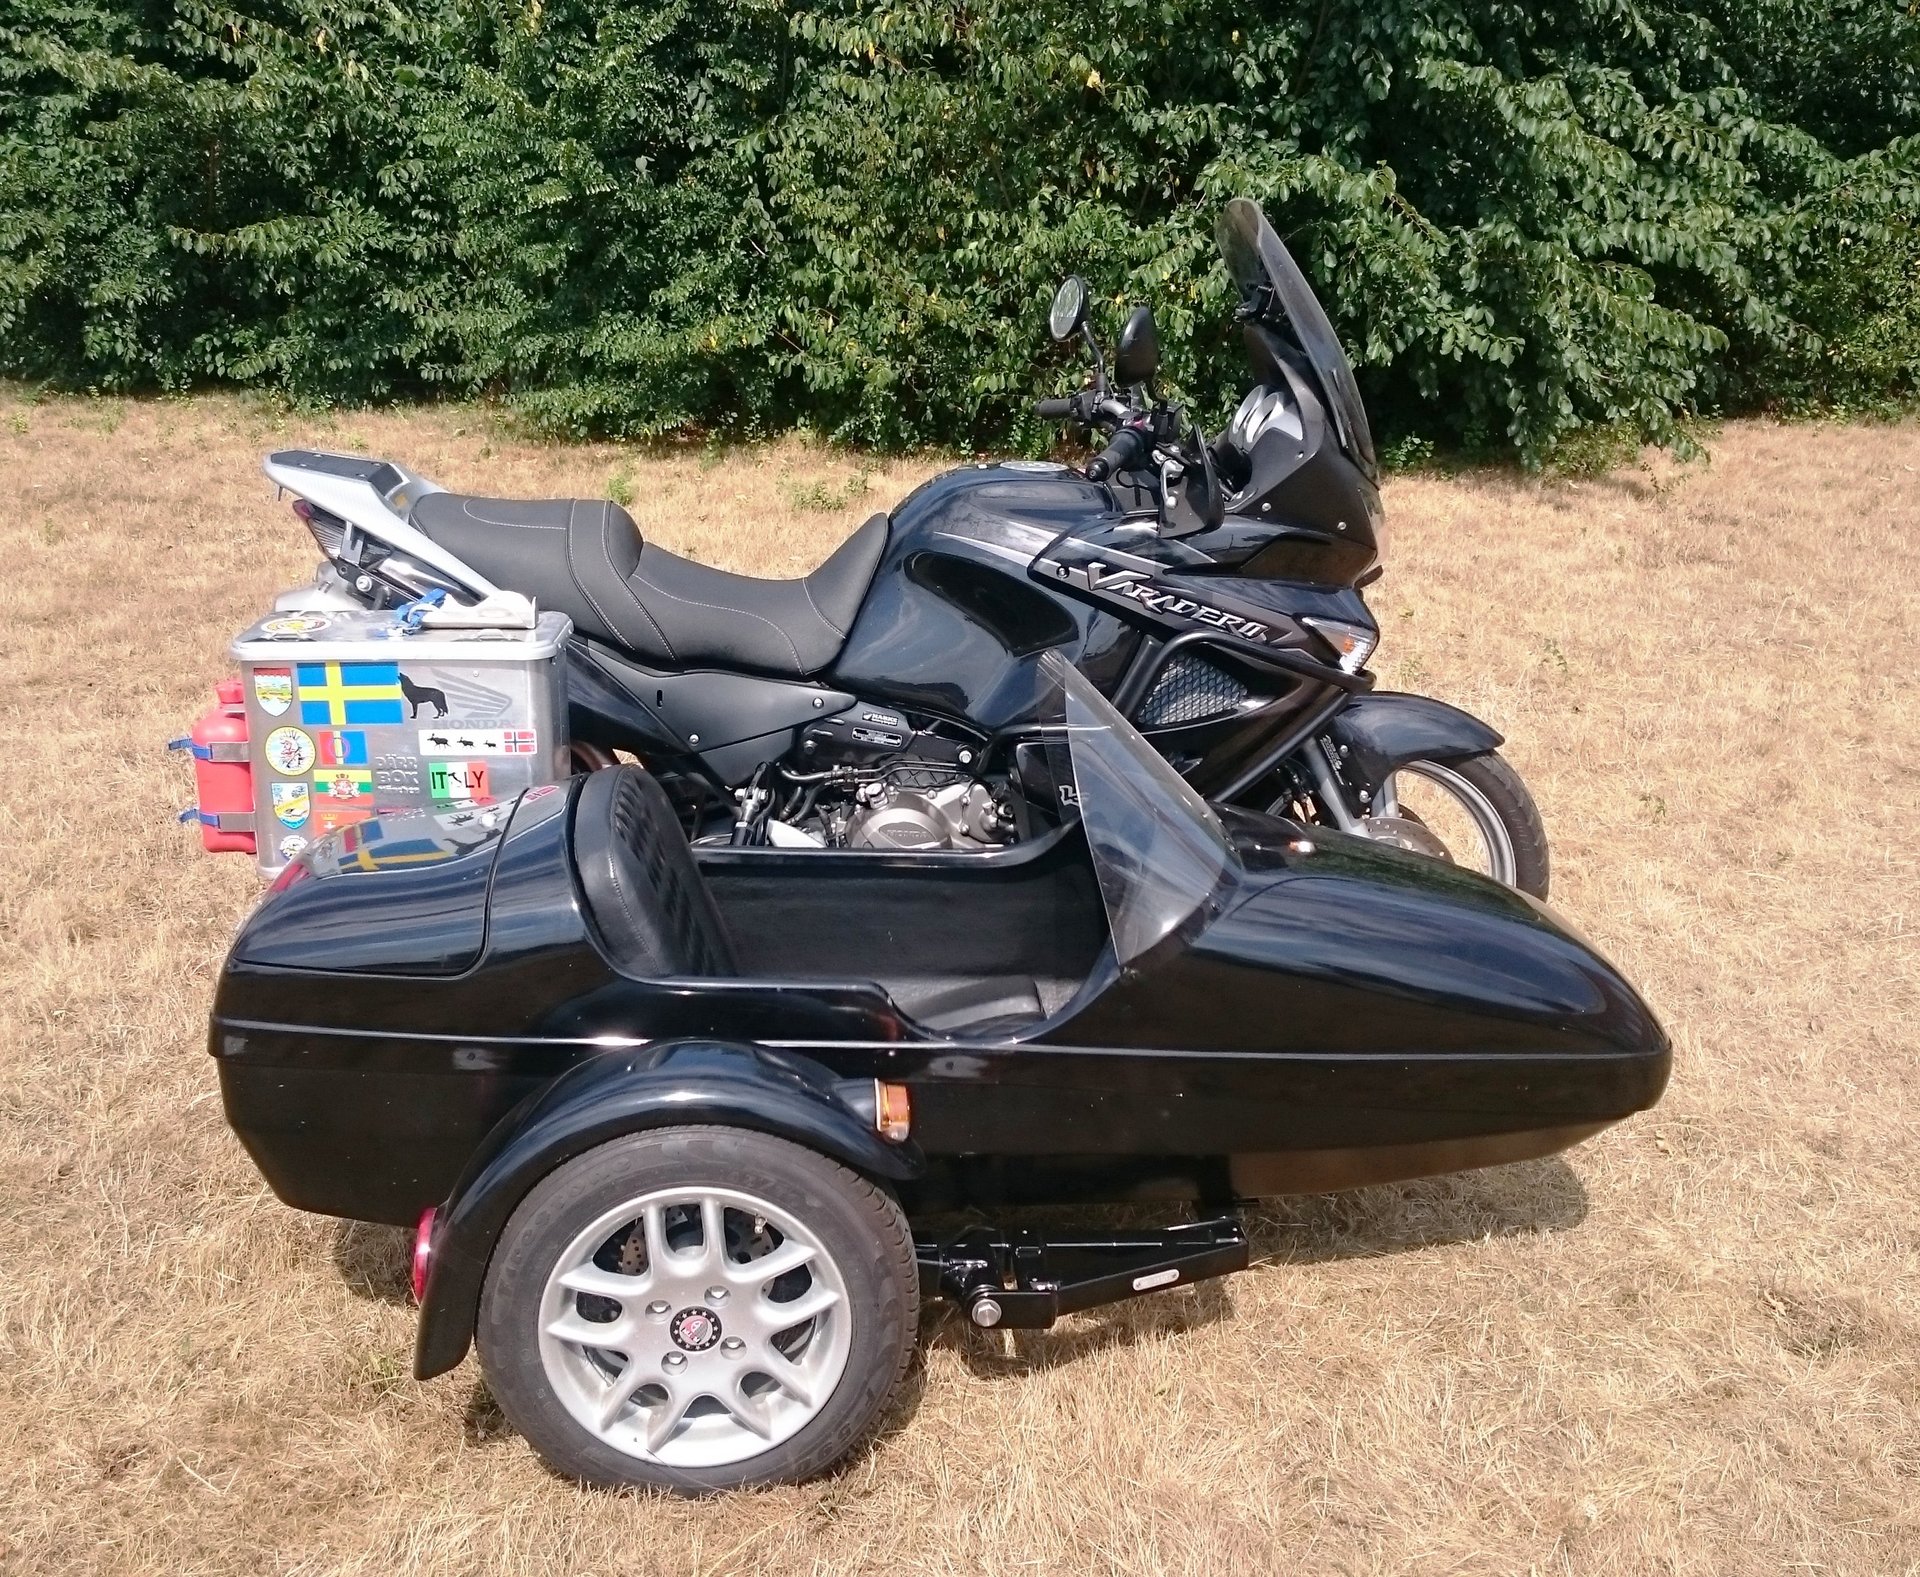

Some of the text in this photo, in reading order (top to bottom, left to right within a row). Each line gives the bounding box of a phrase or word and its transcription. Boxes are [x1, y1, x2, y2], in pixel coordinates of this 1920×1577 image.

[1086, 562, 1270, 641] VARADERO
[431, 719, 514, 730] HONDA
[375, 769, 419, 784] BOX
[431, 771, 484, 790] ITLY
